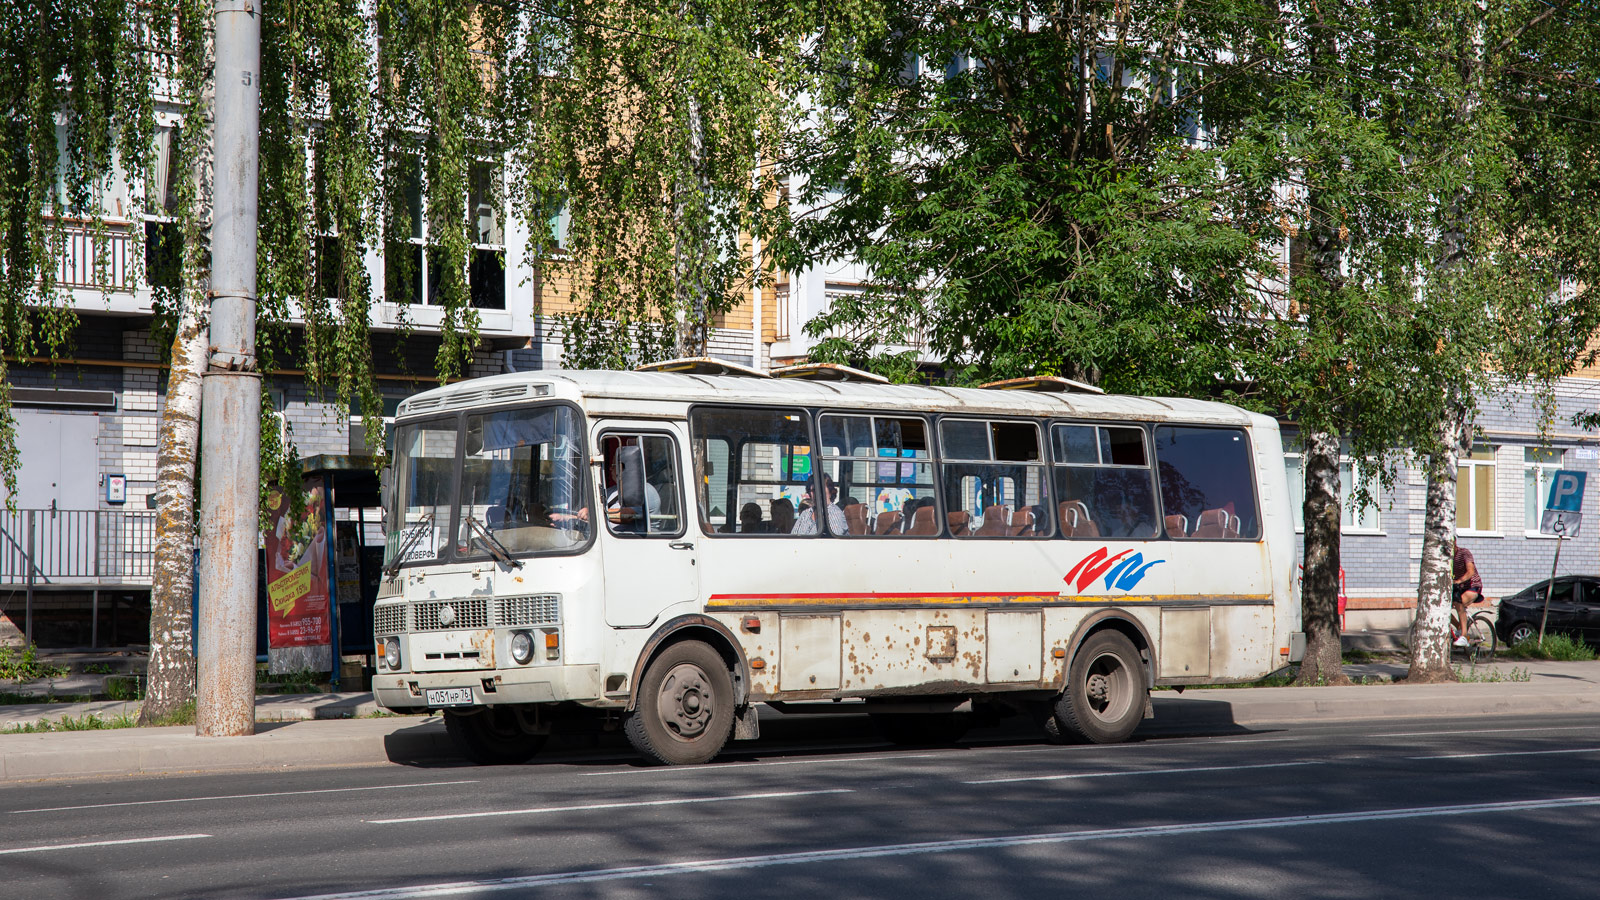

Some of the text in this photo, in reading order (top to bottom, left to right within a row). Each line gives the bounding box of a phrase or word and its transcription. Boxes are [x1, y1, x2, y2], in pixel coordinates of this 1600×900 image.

[1554, 474, 1579, 506] P
[274, 591, 296, 607] Скидка
[296, 582, 308, 595] 15%
